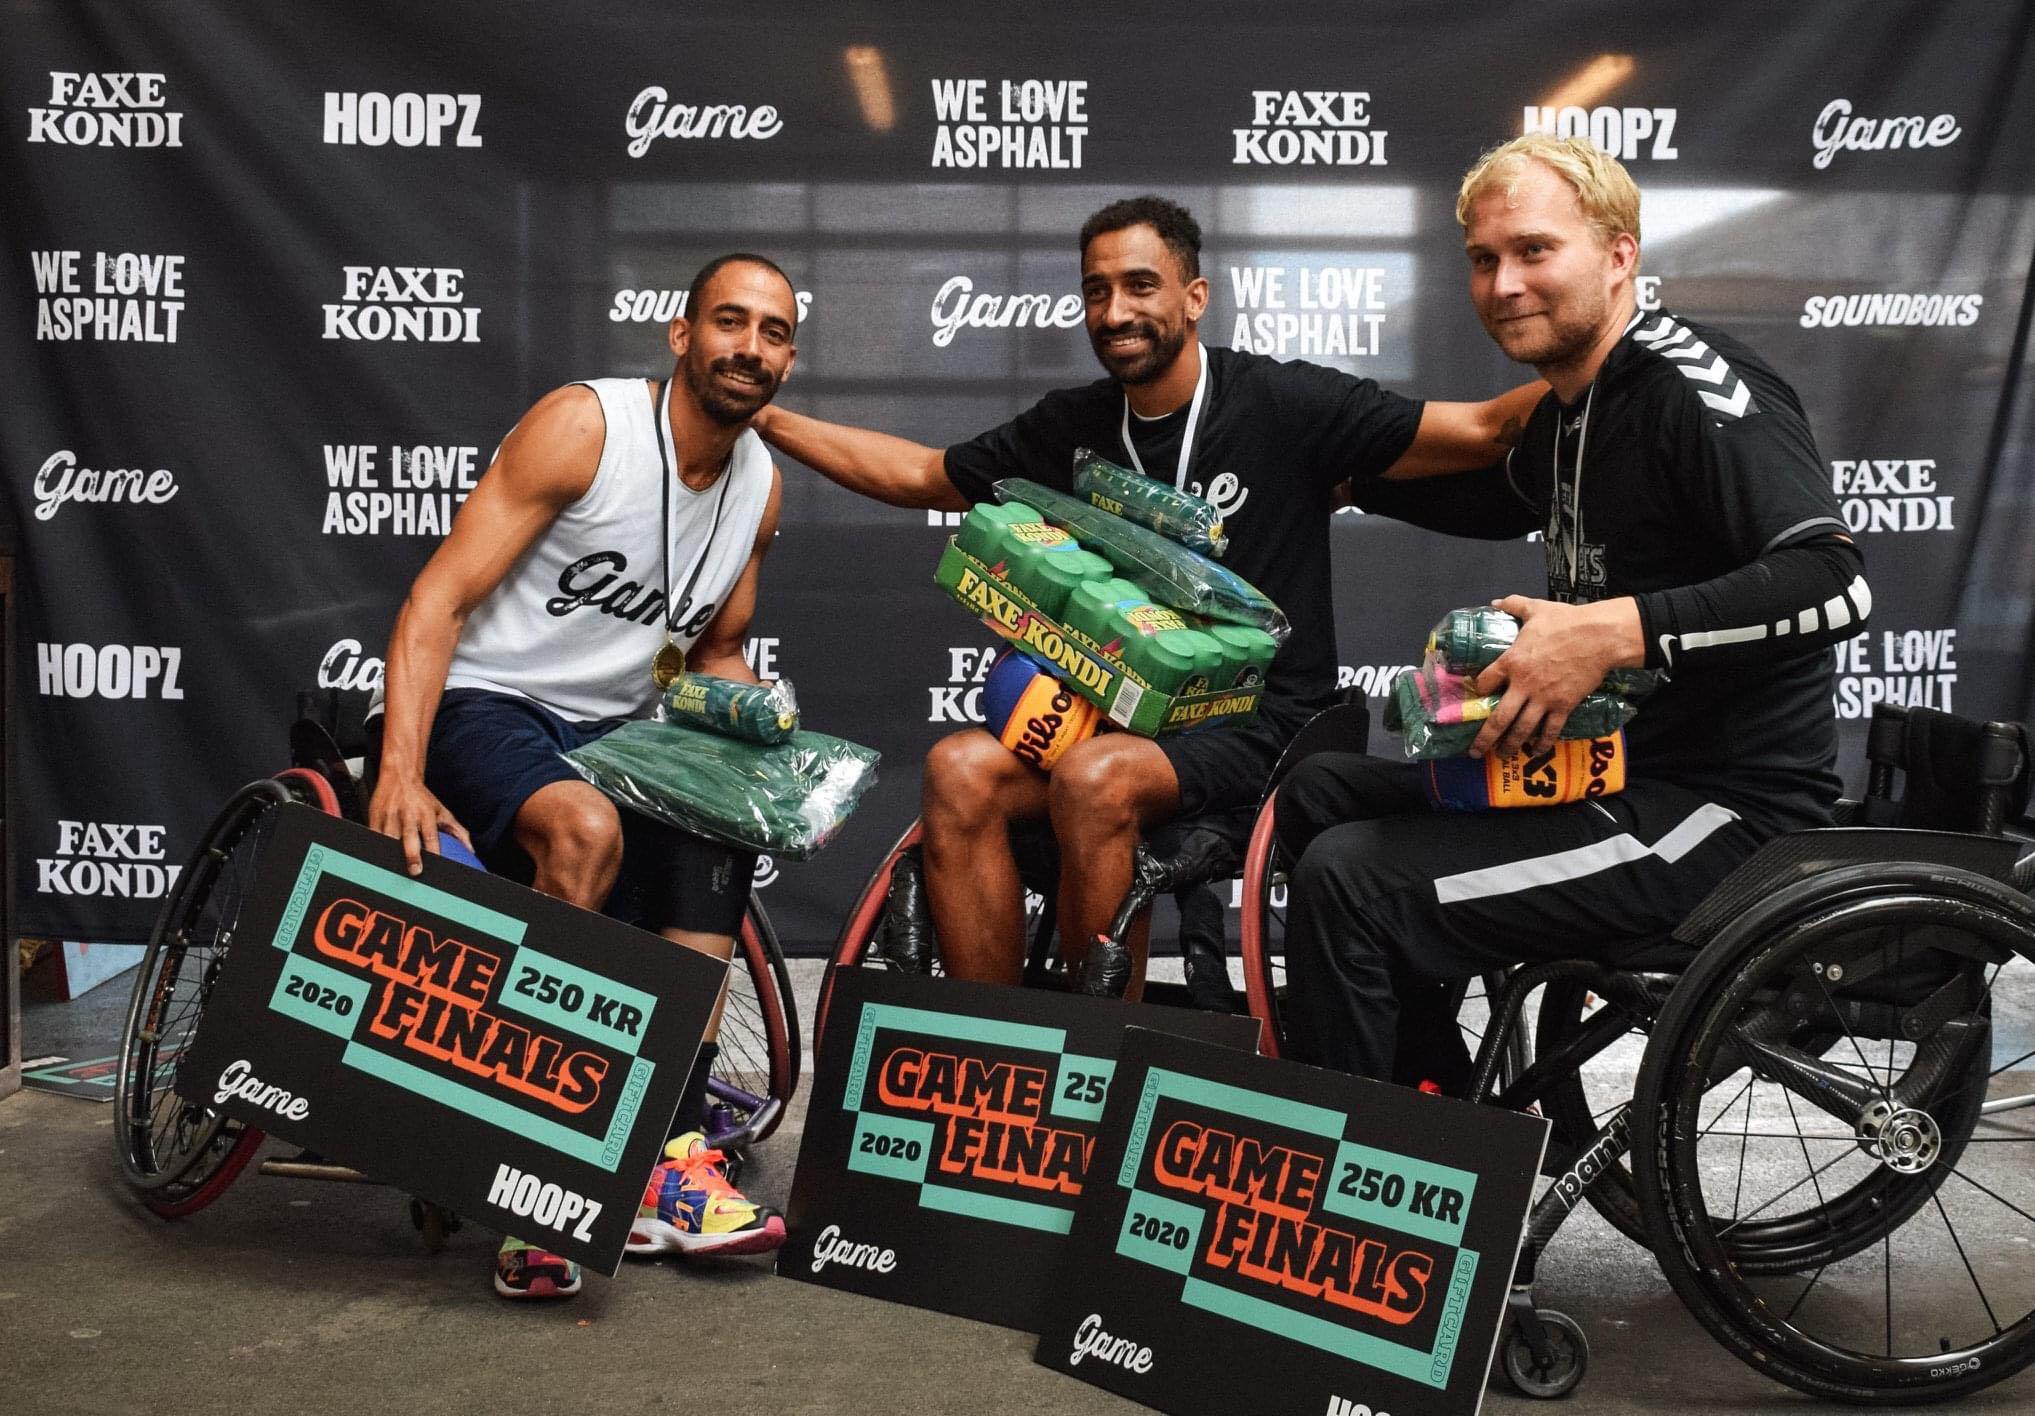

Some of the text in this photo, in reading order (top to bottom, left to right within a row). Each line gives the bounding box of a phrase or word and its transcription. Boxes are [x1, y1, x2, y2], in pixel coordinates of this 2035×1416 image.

[49, 71, 166, 108] FAXE
[931, 79, 1088, 123] WE LOVE
[1252, 90, 1370, 127] FAXE
[27, 108, 183, 148] KONDI
[323, 92, 482, 147] HOOPZ
[625, 86, 783, 158] Game
[1812, 98, 1961, 170] Game
[931, 126, 1088, 168] ASPHALT
[1233, 129, 1388, 166] KONDI
[31, 251, 185, 297] WE LOVE
[343, 266, 464, 303] FAXE
[1231, 267, 1386, 310] WE LOVE
[36, 298, 184, 342] ASPHALT
[322, 304, 481, 342] KONDI
[931, 276, 1085, 347] Game
[1800, 294, 1983, 328] SOUNDBOKS
[1231, 313, 1386, 355] ASPHALT
[34, 449, 178, 520] Game
[323, 445, 478, 488] WE LOVE
[1831, 459, 1936, 494] FAXE
[322, 492, 469, 535] ASPHAL
[1091, 491, 1124, 516] FAXE
[1837, 496, 1955, 533] ONDI
[957, 567, 1023, 632] FAXE
[1023, 617, 1114, 697] KONDI
[1883, 629, 1957, 672] LOVE
[37, 642, 184, 700] HOOPZ
[672, 694, 707, 714] KONDI
[1168, 695, 1256, 723] FAXE KONDI
[1832, 674, 1957, 719] SPHALT
[56, 820, 166, 859] FAXE
[278, 848, 323, 946] GIFTCARD
[314, 898, 500, 1008] GAME
[284, 974, 354, 1017] 2020
[514, 964, 643, 1038] 250 KR
[369, 981, 608, 1113] FINALS
[846, 1007, 876, 1107] GIFTCARD
[214, 1060, 310, 1121] Game
[878, 1048, 1047, 1126] GAME
[1063, 1071, 1107, 1104] 25
[601, 1062, 650, 1167] GIFTCARD
[1121, 1072, 1160, 1183] GIFTCARD
[859, 1132, 921, 1162] 2020
[940, 1117, 1096, 1195] FINA
[1554, 1107, 1632, 1210] pant
[1154, 1120, 1324, 1221] GAME
[487, 1162, 602, 1243] HOOPZ
[1337, 1163, 1464, 1225] 250 KR
[812, 1224, 897, 1273] Game
[1129, 1213, 1190, 1250] 2020
[1207, 1205, 1434, 1325] FINALS
[1431, 1254, 1475, 1383] GIFTCARD
[1070, 1313, 1153, 1373] Game
